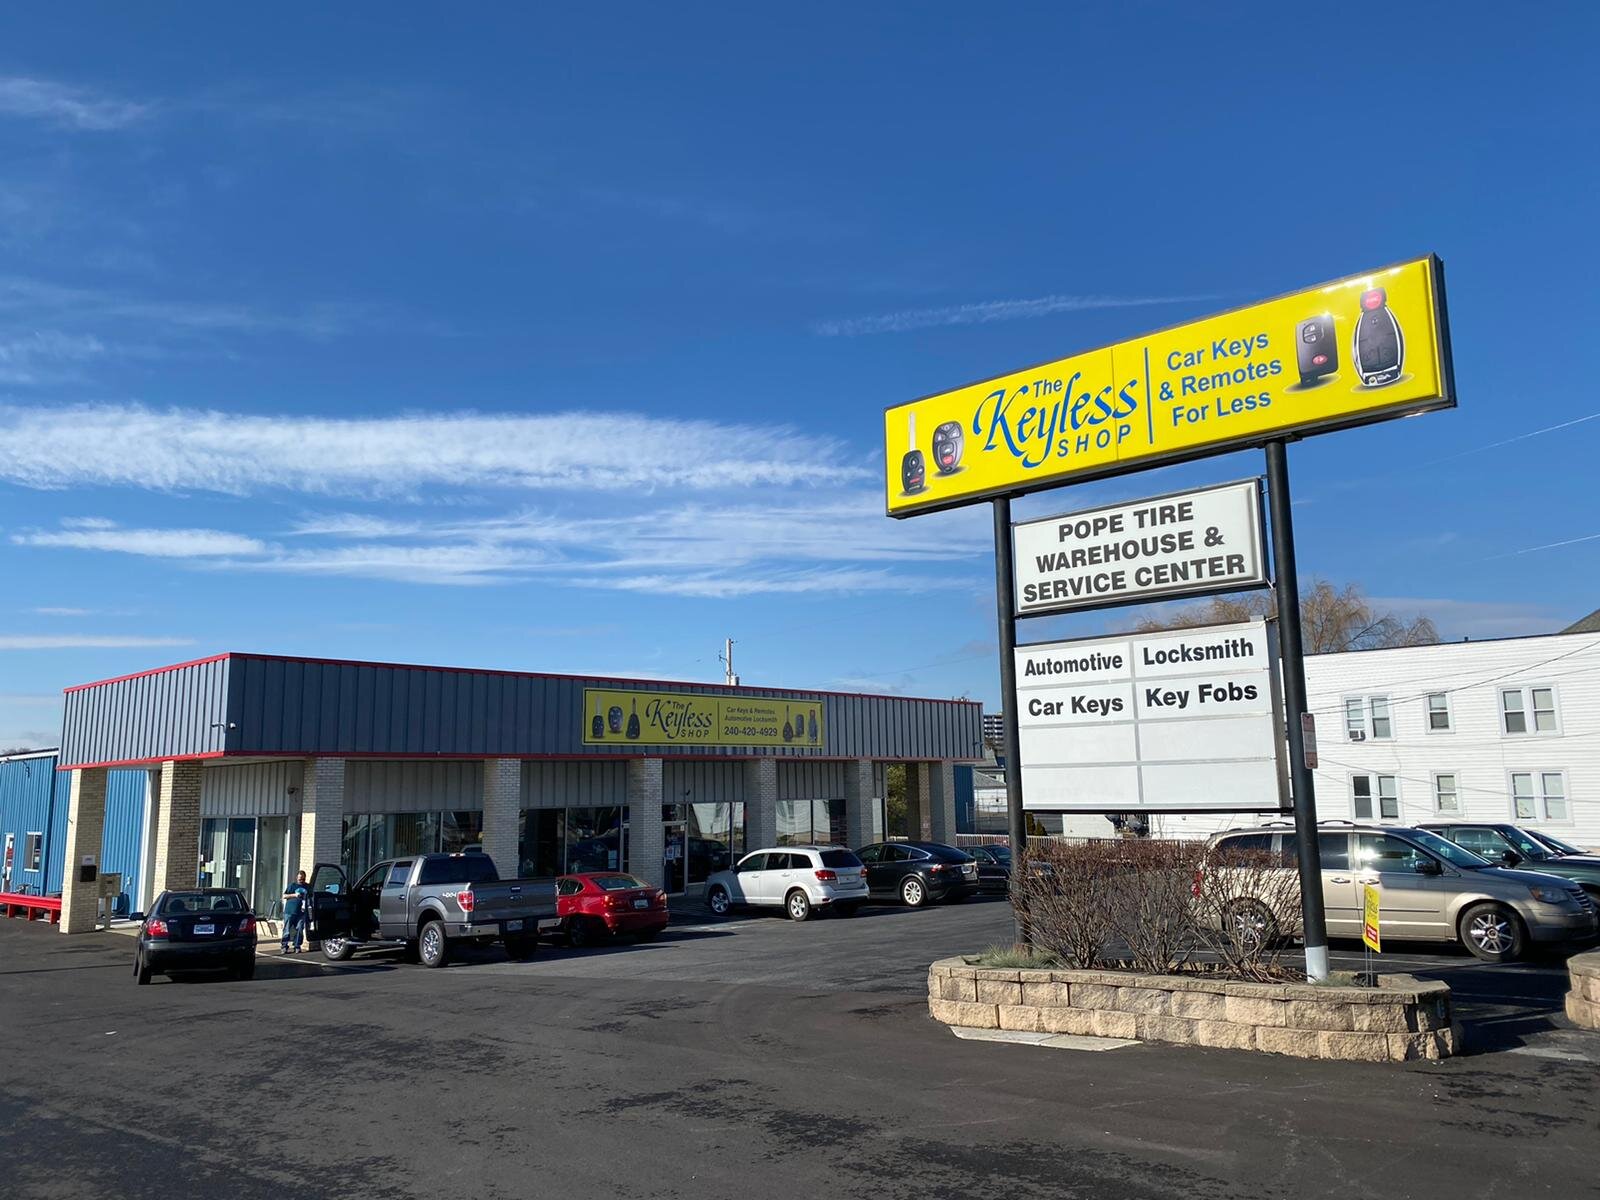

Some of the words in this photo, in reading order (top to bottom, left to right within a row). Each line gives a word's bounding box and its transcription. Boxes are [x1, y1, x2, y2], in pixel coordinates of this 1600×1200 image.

[1167, 348, 1205, 371] Car
[1212, 333, 1269, 361] Keys
[1033, 377, 1063, 398] The
[1159, 381, 1175, 401] &
[1181, 359, 1282, 397] Remotes
[972, 371, 1138, 469] Keyless
[1172, 405, 1209, 427] For
[1216, 391, 1271, 417] Less
[1057, 424, 1131, 458] SHOP
[1059, 513, 1124, 543] POPE
[1133, 501, 1194, 530] TIRE
[1036, 530, 1194, 574] WAREHOUSE
[1204, 526, 1225, 547] &
[1023, 570, 1127, 603] SERVICE
[1134, 553, 1245, 586] CENTER
[1024, 652, 1123, 677] Automotive
[1143, 637, 1254, 666] Locksmith
[672, 701, 686, 710] The
[1028, 698, 1064, 717] Car
[1071, 695, 1124, 717] Keys
[1145, 687, 1190, 709] Key
[1198, 682, 1258, 704] Fobs
[645, 699, 712, 739] Keyless
[724, 714, 752, 722] Automotive
[753, 715, 778, 723] Locksmith
[737, 706, 749, 715] Keys
[680, 729, 710, 738] SHOP
[724, 726, 778, 737] 240-420-4929
